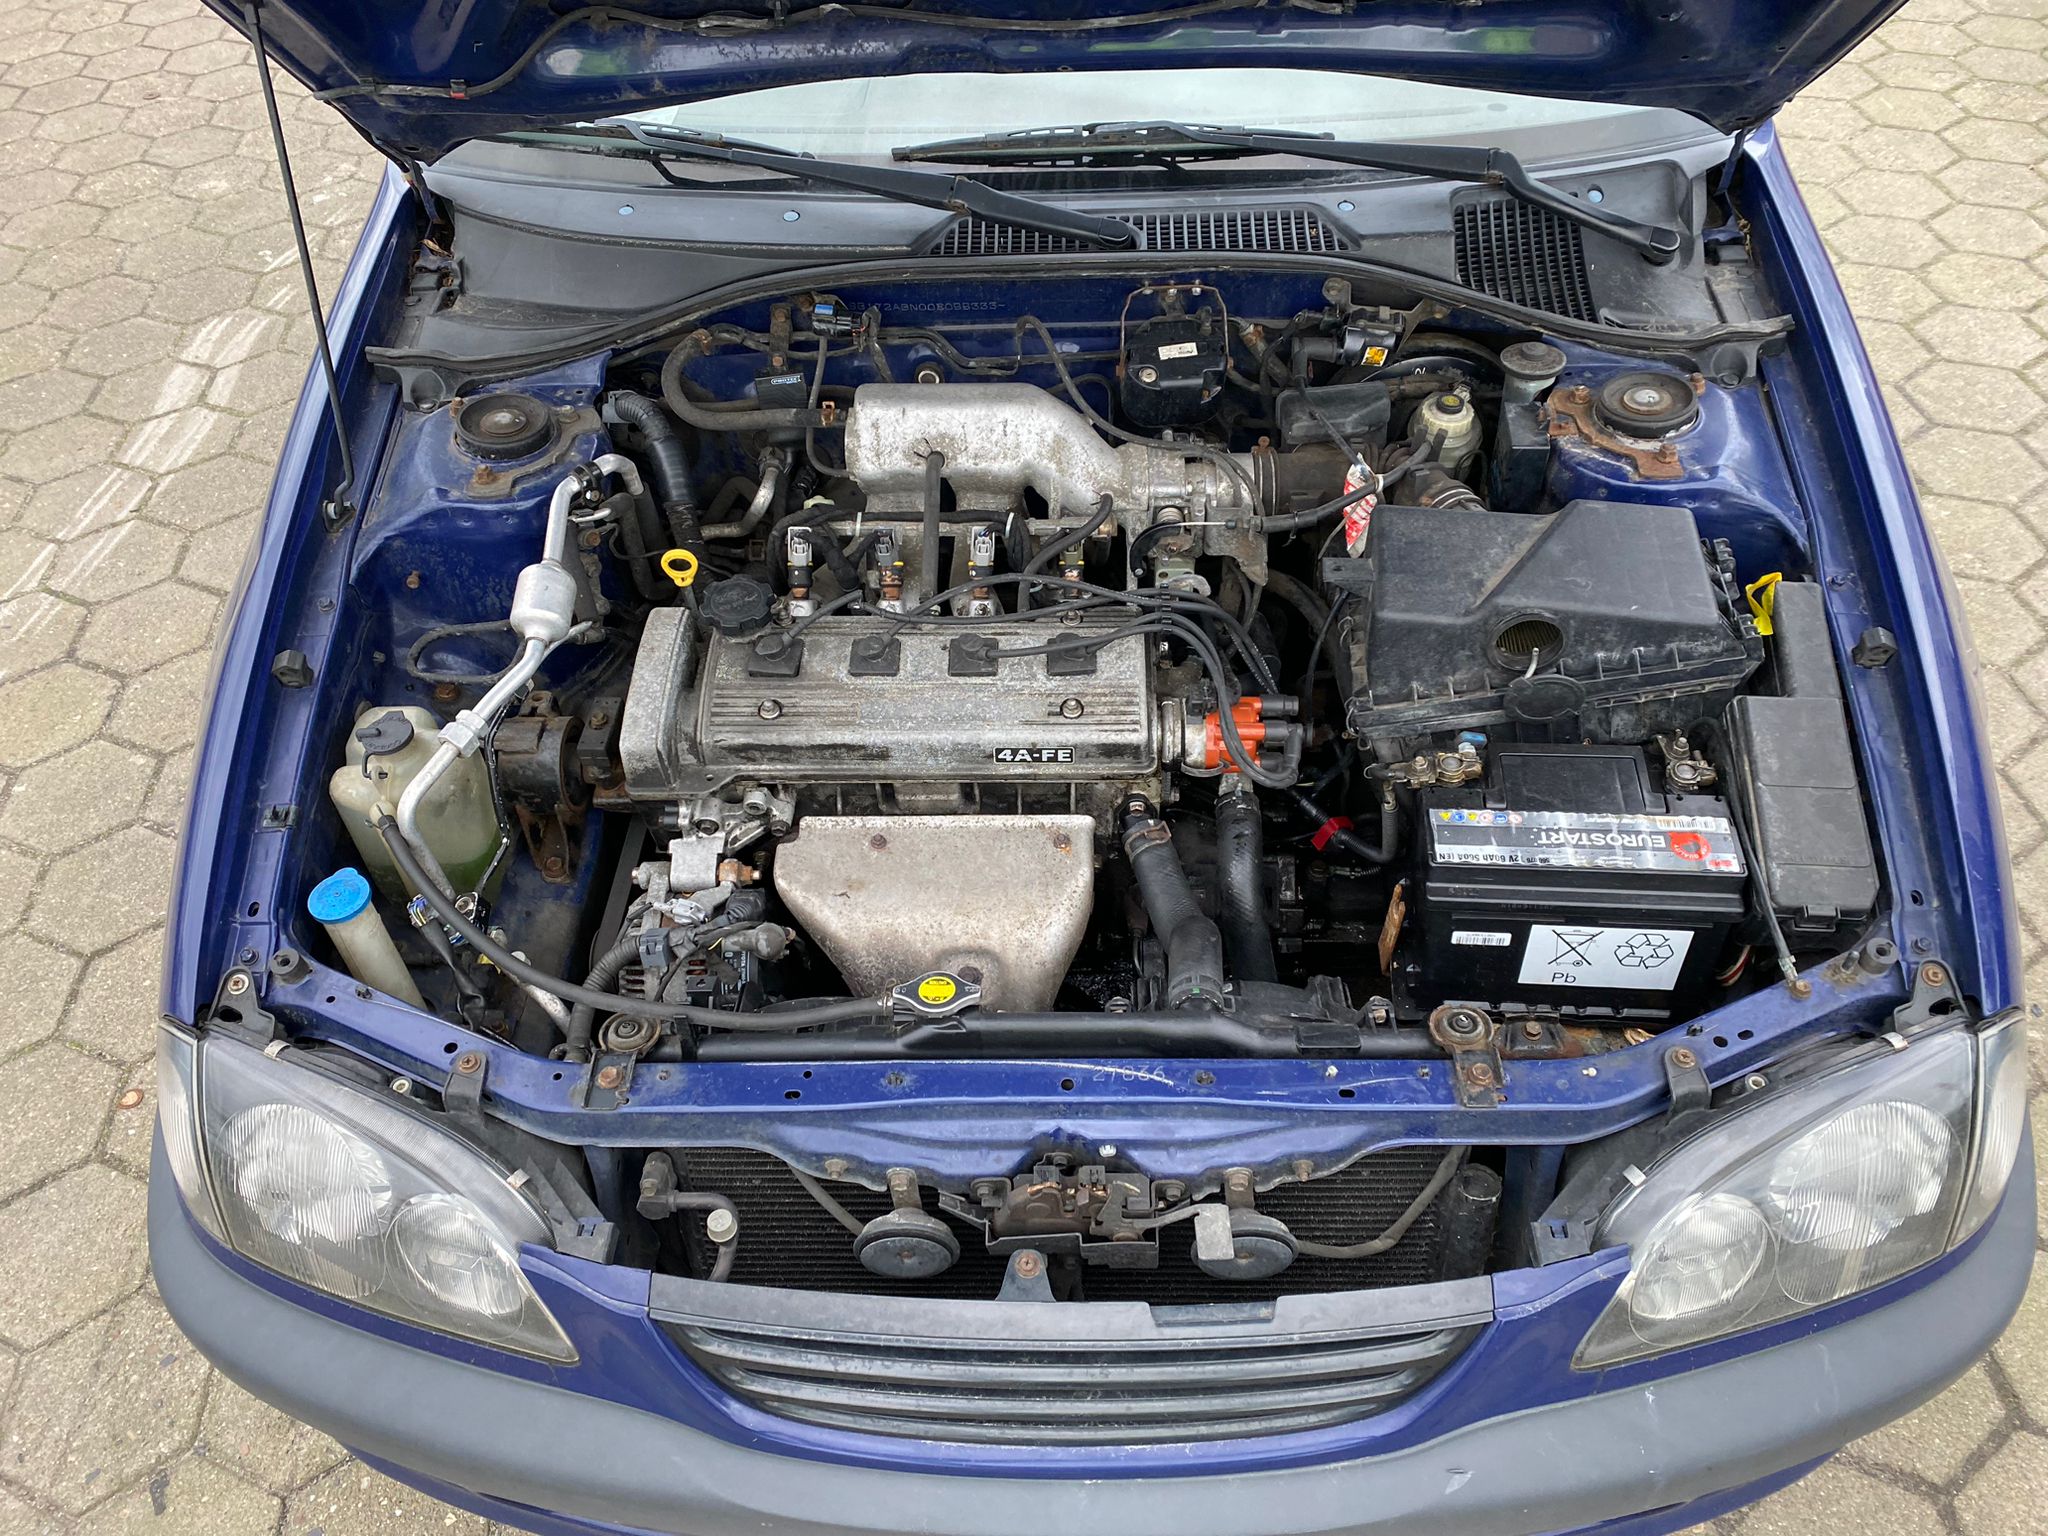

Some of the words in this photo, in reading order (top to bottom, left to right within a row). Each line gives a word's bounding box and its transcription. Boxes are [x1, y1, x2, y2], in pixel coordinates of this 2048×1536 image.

[997, 749, 1072, 762] 4A-FE
[1537, 831, 1667, 848] EUROSTART
[1551, 972, 1577, 984] Pb
